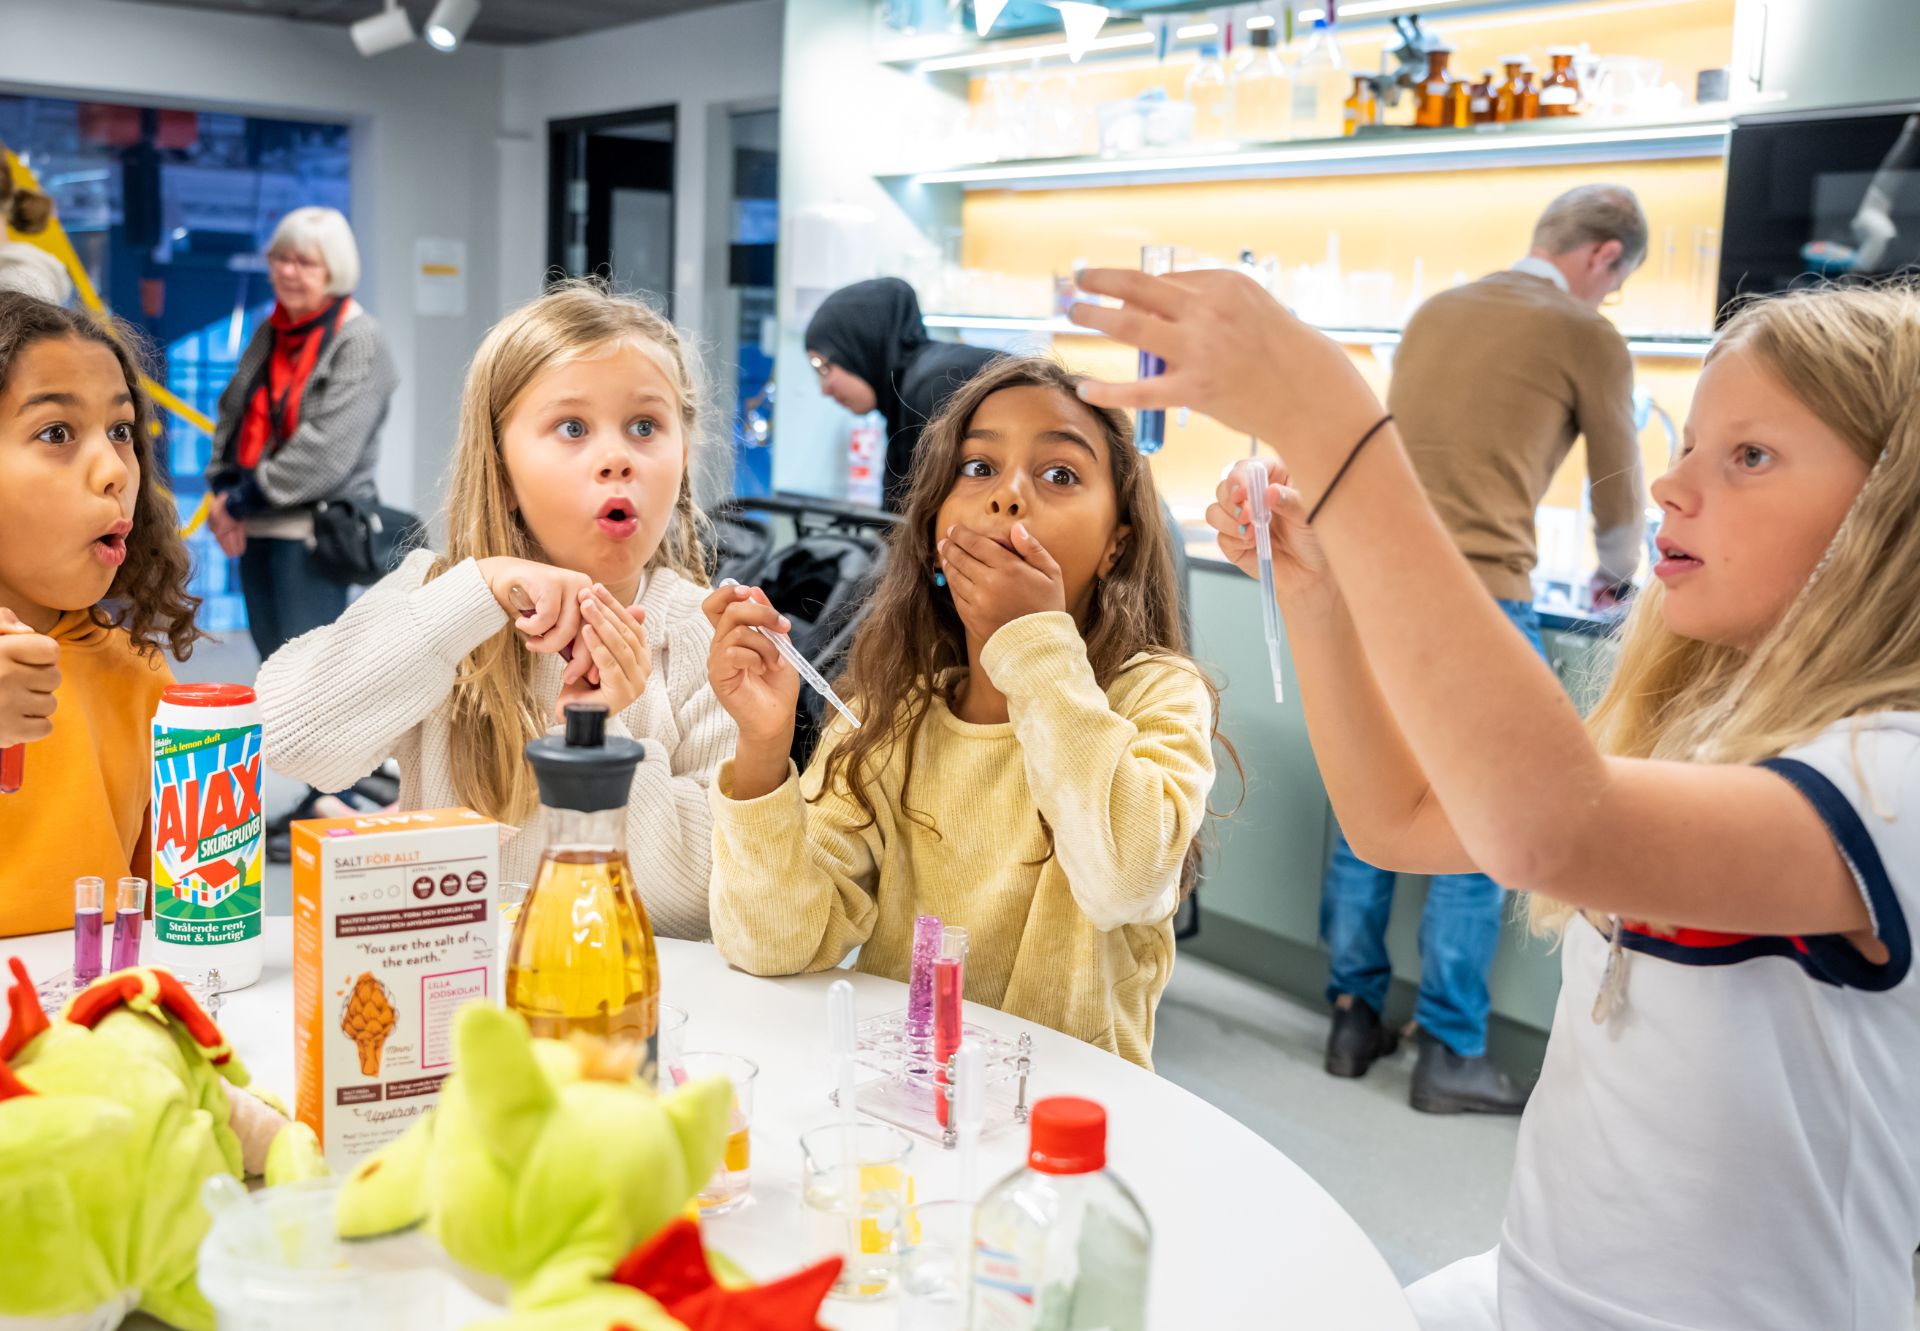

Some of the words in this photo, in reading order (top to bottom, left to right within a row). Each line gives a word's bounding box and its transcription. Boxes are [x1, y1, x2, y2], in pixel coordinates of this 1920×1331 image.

[164, 744, 178, 754] frisk
[179, 740, 202, 751] lemon
[204, 732, 221, 745] duft
[156, 751, 262, 863] AJAX
[201, 815, 261, 859] SKUREPULVER
[335, 856, 363, 869] SALT
[365, 853, 390, 866] FÖR
[394, 851, 421, 864] ALLT
[169, 921, 219, 933] Strålende
[222, 920, 246, 931] rent,
[166, 932, 191, 942] nemt
[194, 933, 204, 942] &
[207, 930, 244, 942] hurtigt
[389, 943, 408, 952] are
[411, 938, 431, 950] the
[434, 934, 454, 947] salt
[458, 930, 470, 943] of
[382, 956, 402, 968] the
[428, 980, 451, 990] LILLA
[430, 985, 481, 999] JODSKOLAN
